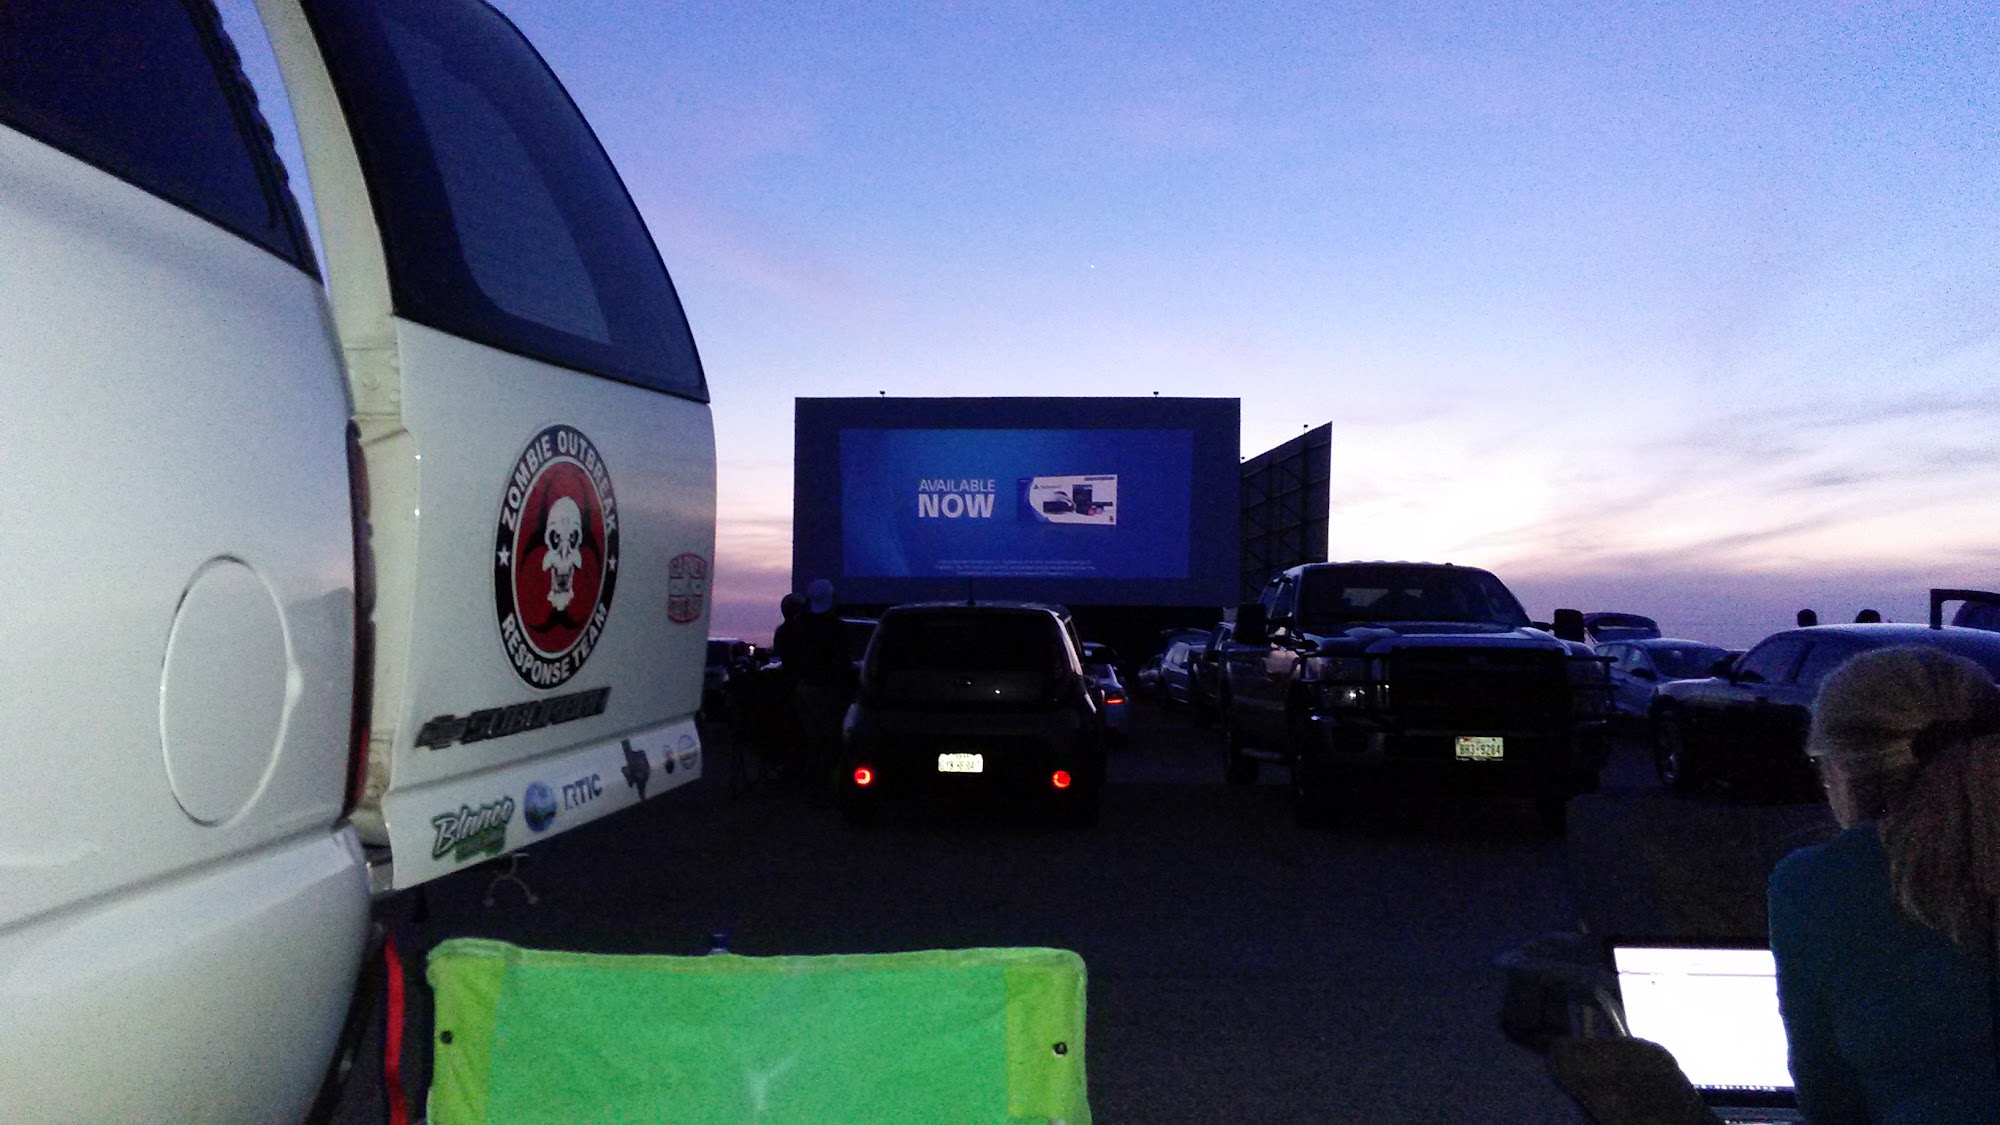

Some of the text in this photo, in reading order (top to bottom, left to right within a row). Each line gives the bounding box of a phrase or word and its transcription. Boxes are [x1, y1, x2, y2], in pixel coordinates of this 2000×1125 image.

[503, 431, 618, 532] ZOMBIE OUTBREAK
[918, 479, 995, 492] AVAILABLE
[918, 494, 995, 518] NOW
[502, 602, 608, 685] RESPONSE TEAM
[562, 774, 602, 811] RTIC
